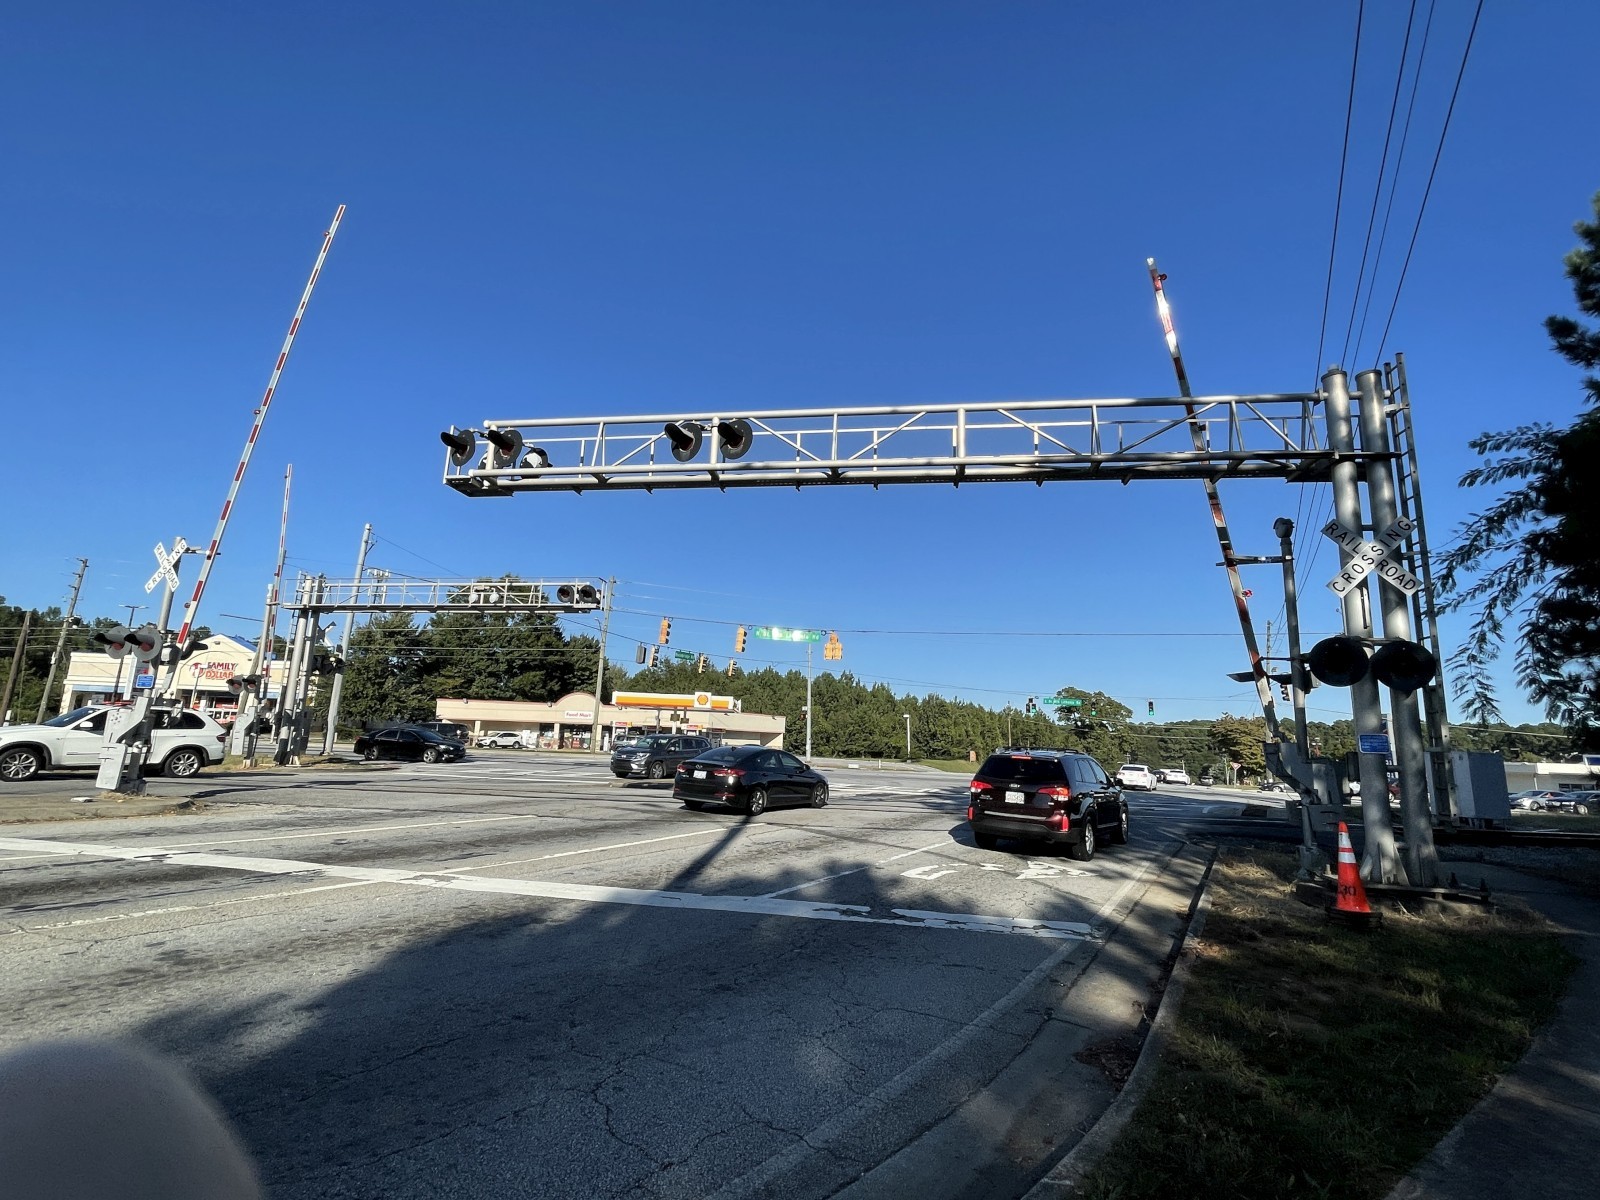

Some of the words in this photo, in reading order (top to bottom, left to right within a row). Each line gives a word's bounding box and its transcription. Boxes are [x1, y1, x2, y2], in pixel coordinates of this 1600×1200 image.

[146, 542, 186, 591] CROSSING
[1332, 520, 1411, 592] CROSSING
[205, 669, 235, 680] DOLLAR
[207, 661, 236, 671] FAMILY
